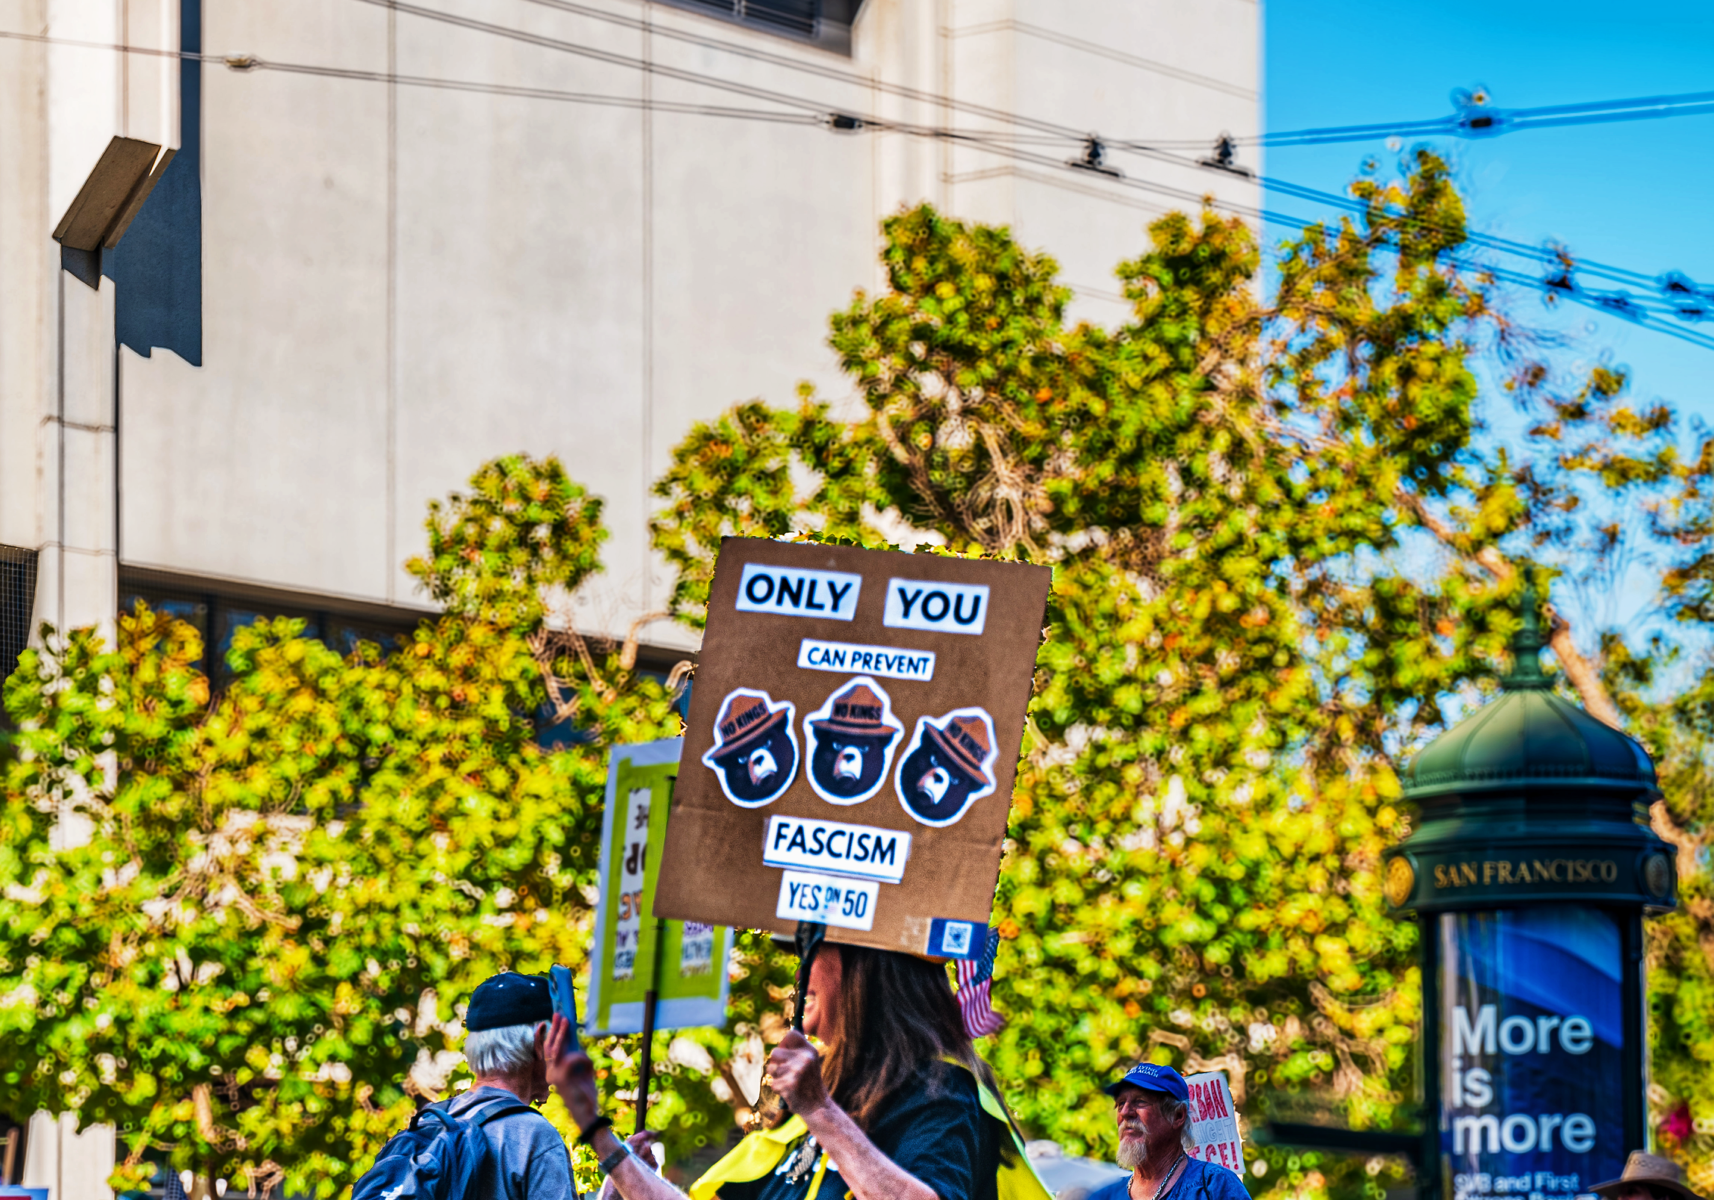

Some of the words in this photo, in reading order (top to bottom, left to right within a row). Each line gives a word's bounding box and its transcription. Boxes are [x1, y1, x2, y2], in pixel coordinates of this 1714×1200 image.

[745, 573, 853, 613] ONLY
[897, 587, 982, 626] YOU
[807, 647, 847, 667] CAN
[851, 651, 930, 675] PREVENT
[721, 721, 736, 738] NO
[735, 702, 766, 730] KINGS
[834, 703, 848, 718] NO
[850, 704, 881, 720] KINGS
[948, 722, 962, 739] NO
[958, 732, 987, 763] KINGS
[774, 822, 896, 866] FASCISM
[1434, 861, 1477, 889] SAN
[1483, 859, 1618, 886] FRANCISCO
[789, 881, 822, 911] YES
[825, 886, 841, 904] ON
[842, 890, 868, 918] 50
[1452, 1004, 1594, 1056] More
[1452, 1057, 1494, 1108] is
[1452, 1113, 1596, 1155] more
[1494, 1172, 1531, 1192] and
[1534, 1172, 1580, 1192] First
